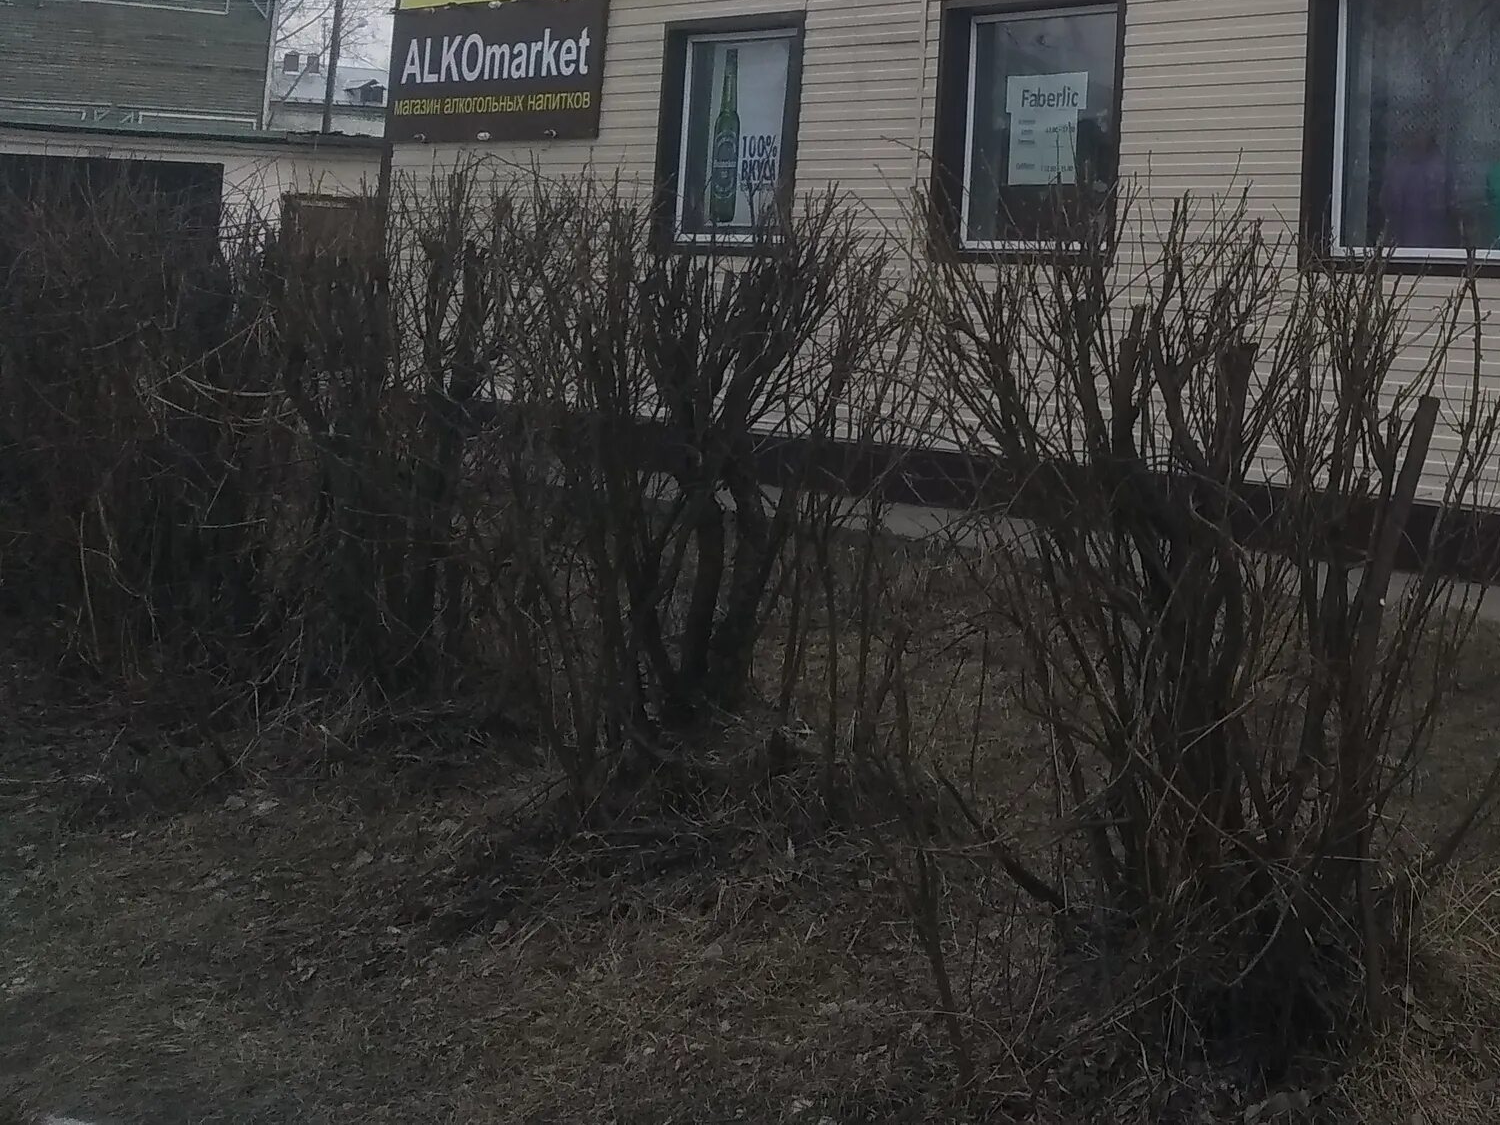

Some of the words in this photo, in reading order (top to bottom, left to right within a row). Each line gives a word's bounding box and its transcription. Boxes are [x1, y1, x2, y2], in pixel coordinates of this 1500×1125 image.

[400, 27, 591, 85] ALKOmarket
[394, 98, 441, 115] магазин
[443, 94, 523, 115] алкогольных
[527, 91, 591, 111] напитков
[1021, 85, 1079, 108] Faberlic
[742, 134, 778, 159] 100%
